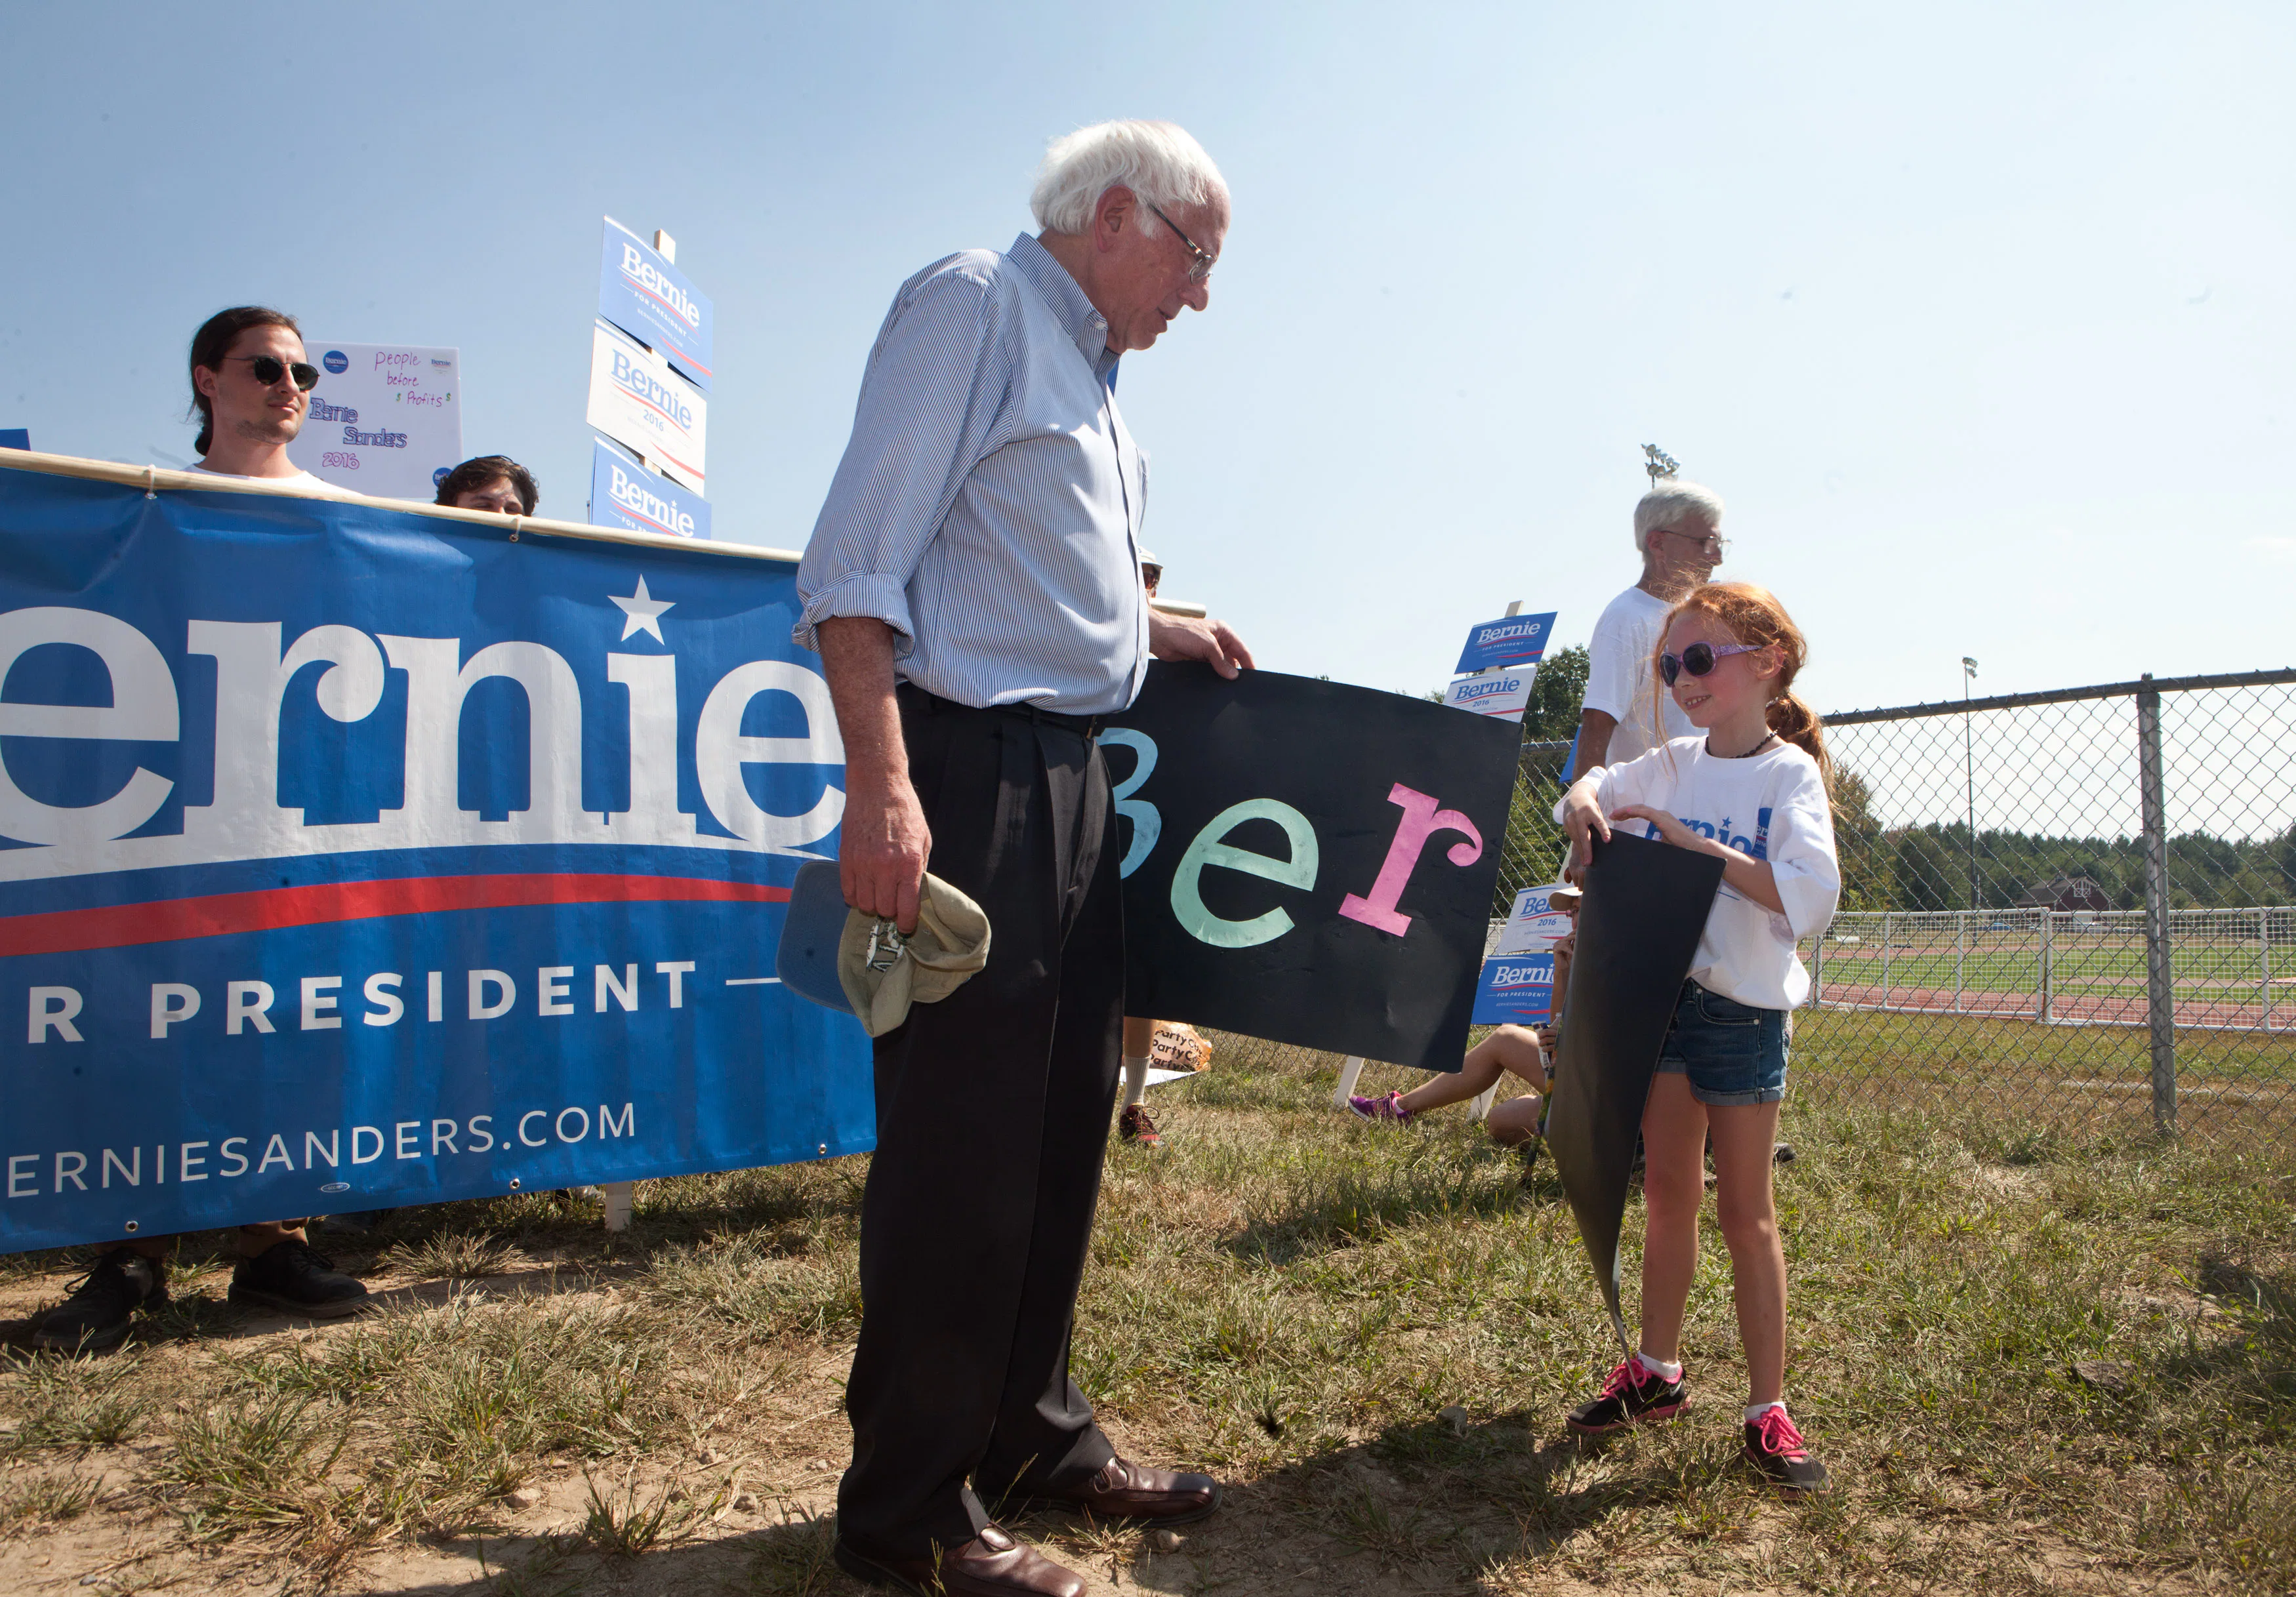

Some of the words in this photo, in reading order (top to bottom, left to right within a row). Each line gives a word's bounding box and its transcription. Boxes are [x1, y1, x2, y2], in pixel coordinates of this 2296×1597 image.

[621, 242, 700, 328] Bernie
[387, 370, 420, 387] before
[611, 348, 692, 431] Bernie
[407, 390, 443, 407] Profits
[310, 397, 358, 424] Bernie
[644, 409, 664, 432] 2016
[342, 426, 408, 449] Sanders
[322, 451, 360, 470] 2016
[609, 464, 695, 538] Bernie
[1477, 620, 1541, 643] Bernie
[1454, 677, 1521, 700] Bernie
[1473, 699, 1490, 708] 2016
[1537, 918, 1557, 927] 2016
[150, 960, 696, 1040] PRESIDENT
